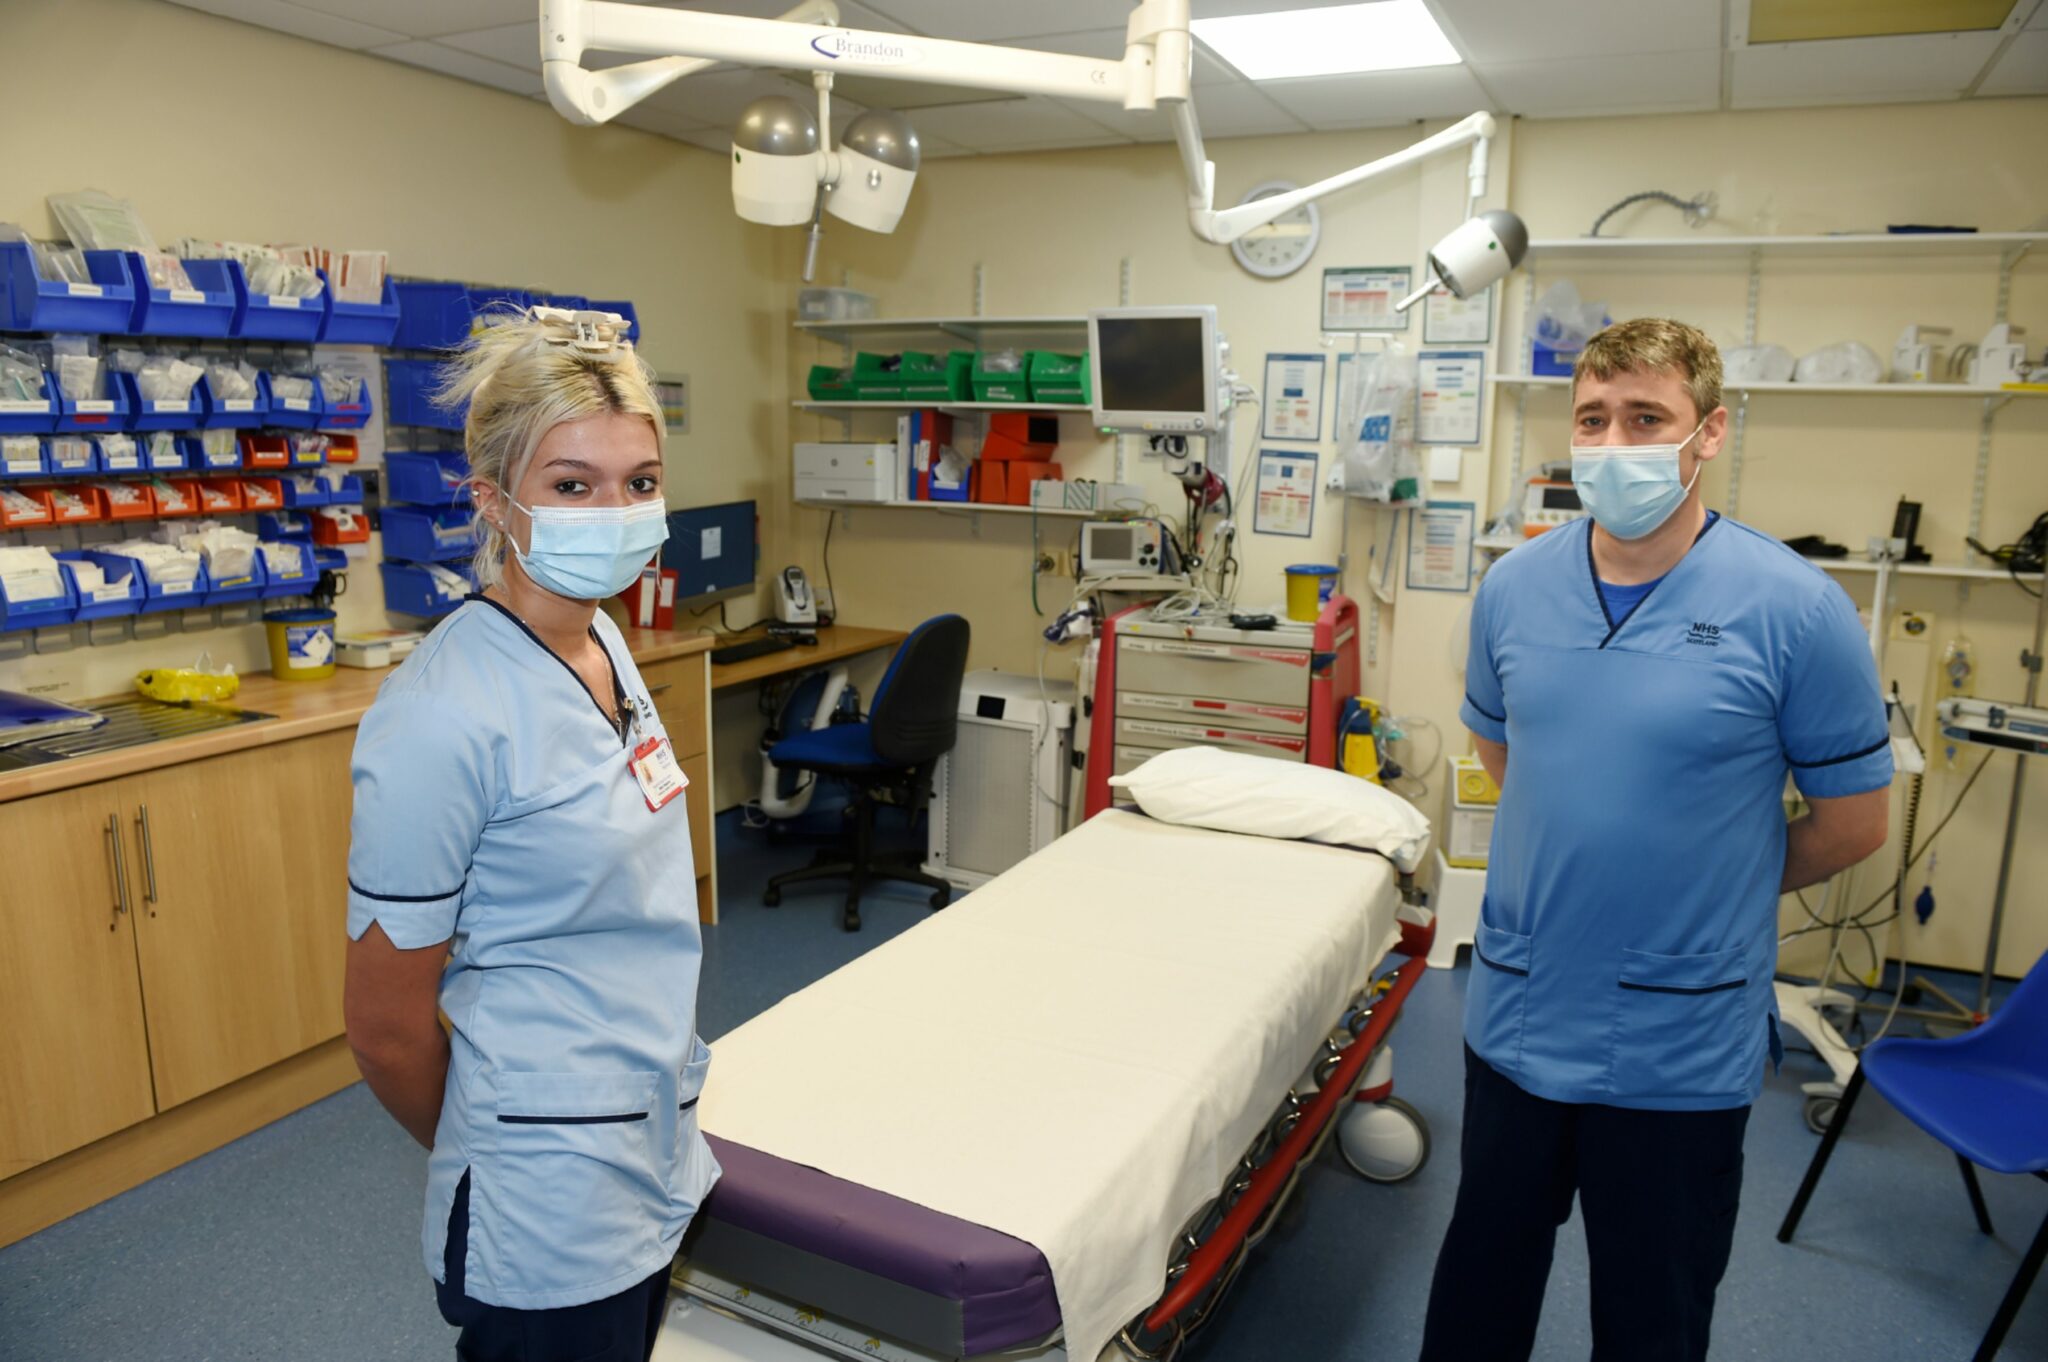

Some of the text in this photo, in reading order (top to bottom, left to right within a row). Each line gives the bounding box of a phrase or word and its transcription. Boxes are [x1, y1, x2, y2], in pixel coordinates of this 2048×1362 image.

[834, 37, 905, 58] Brandon
[1692, 622, 1720, 635] NHS
[1686, 637, 1719, 647] SCOTLAND
